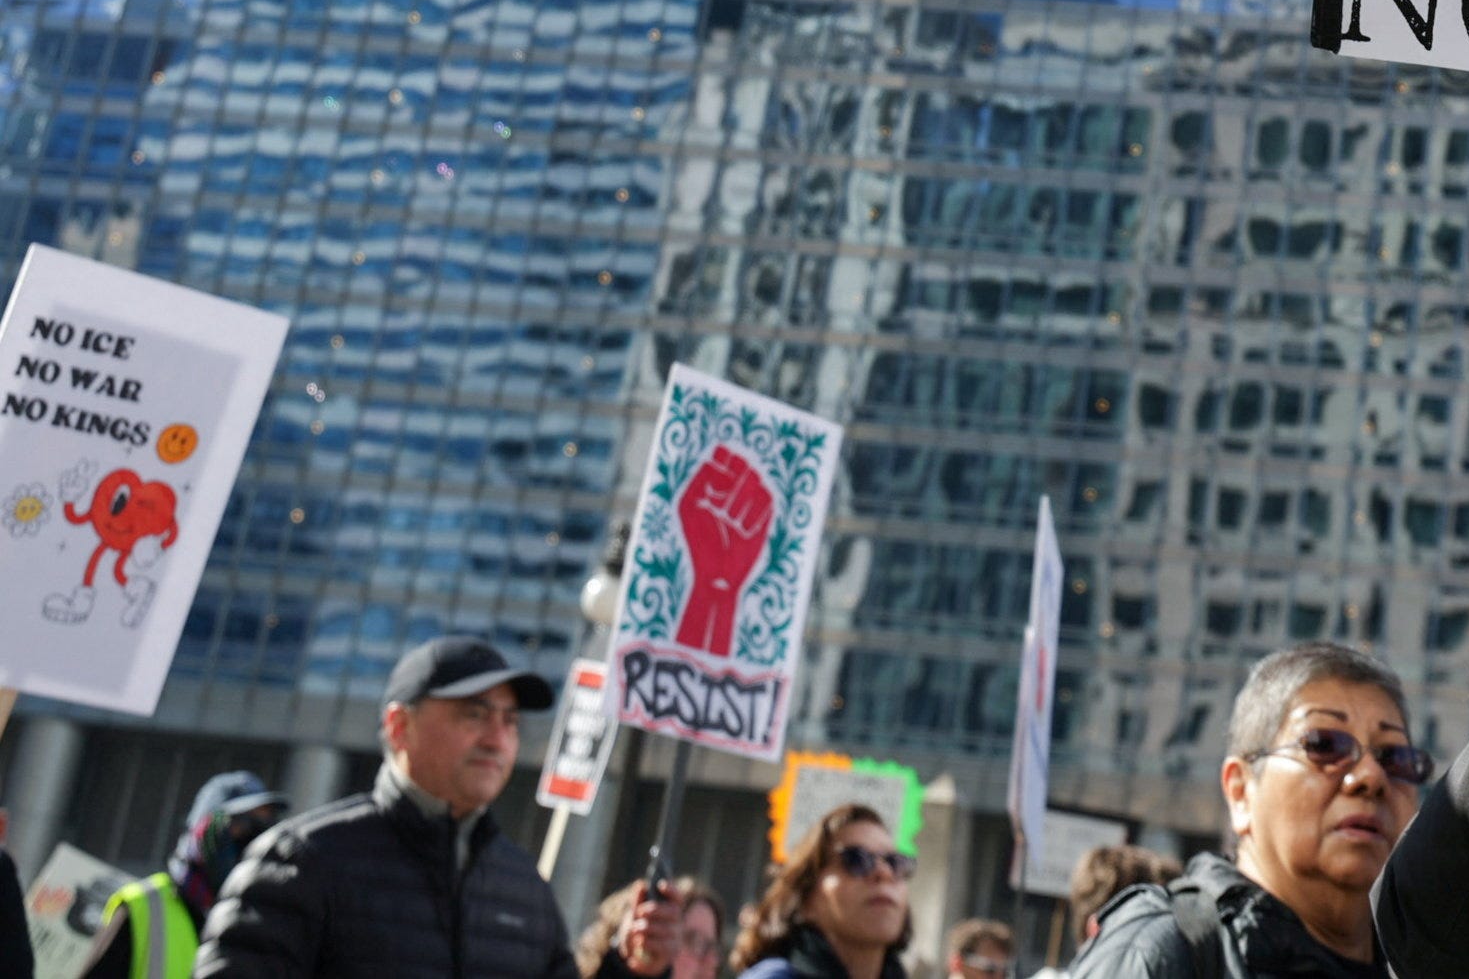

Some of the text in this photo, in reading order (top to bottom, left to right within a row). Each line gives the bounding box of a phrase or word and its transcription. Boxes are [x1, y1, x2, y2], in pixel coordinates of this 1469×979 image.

[30, 317, 135, 360] NO ICE
[15, 354, 143, 403] NO WAR
[1, 393, 151, 447] NO KINGS
[623, 651, 781, 744] RESIST!
